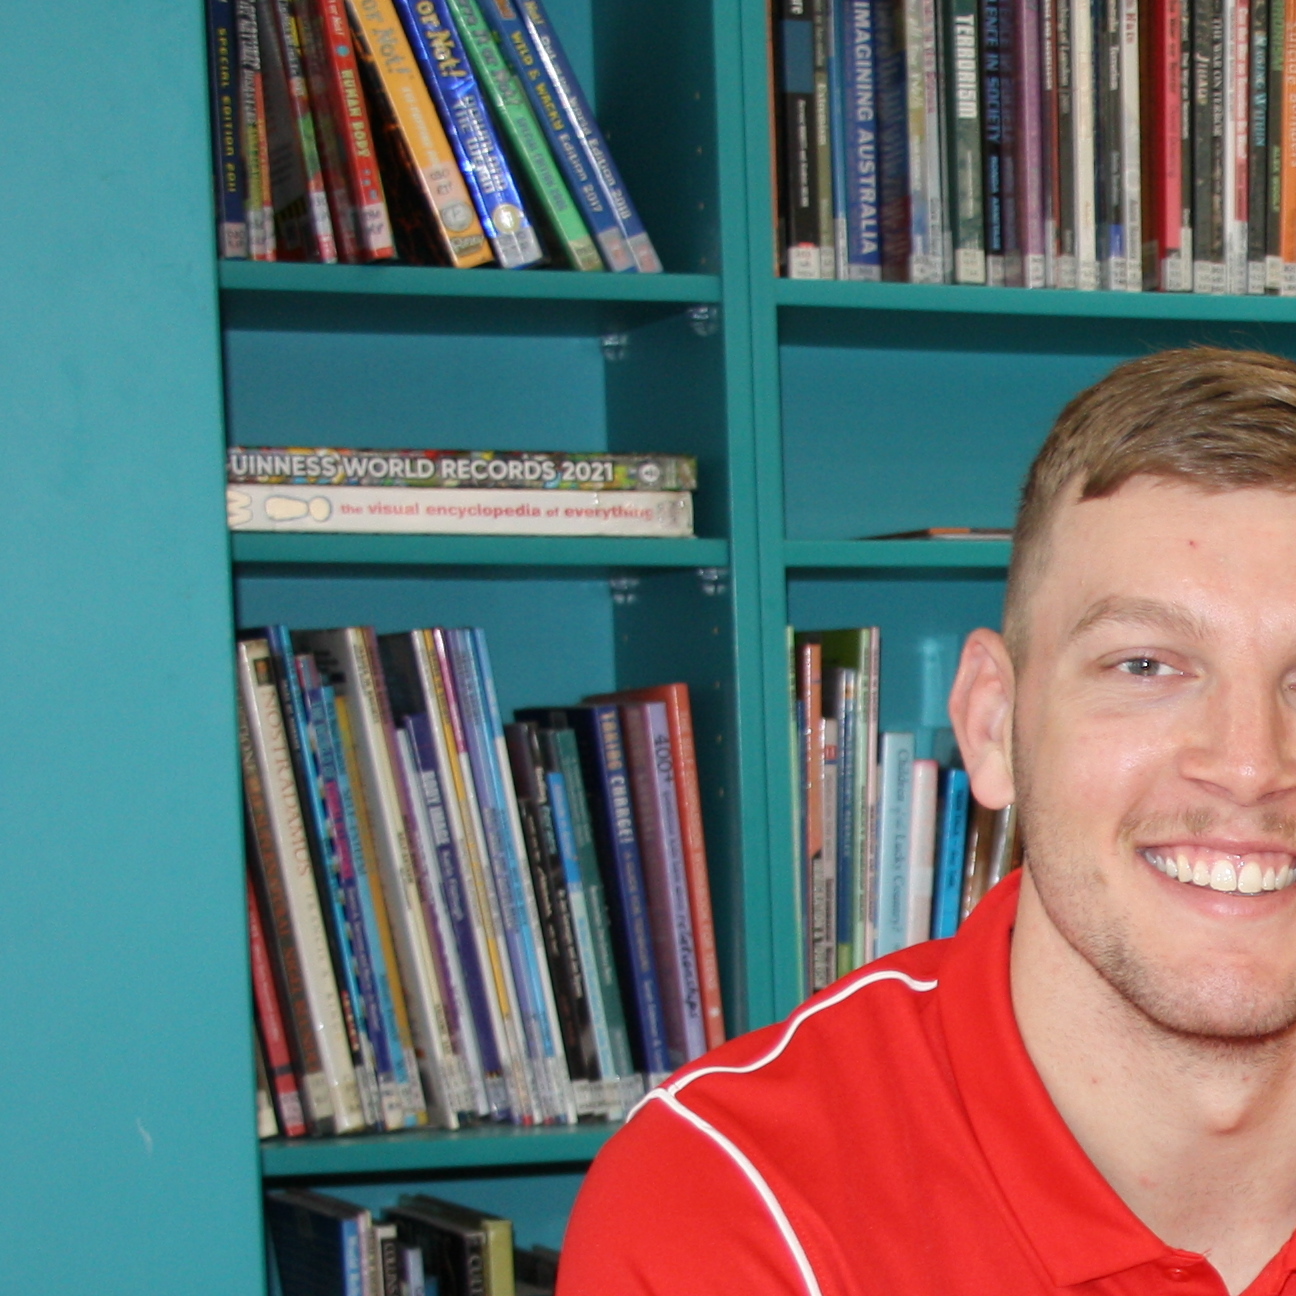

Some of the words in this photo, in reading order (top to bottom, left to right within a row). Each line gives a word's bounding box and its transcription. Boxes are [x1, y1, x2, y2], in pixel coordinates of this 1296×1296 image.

[426, 24, 467, 83] Not!
[853, 1, 873, 121] IMAGINING
[952, 13, 976, 118] TERRORISM
[985, 53, 1000, 71] IN
[1212, 42, 1223, 67] WAR
[340, 68, 361, 116] HUMAN
[986, 76, 1002, 144] SOCIETY
[1211, 90, 1222, 136] TERROR
[350, 120, 370, 159] BODY
[856, 128, 877, 252] AUSTRALIA
[231, 455, 339, 477] UINNESS
[342, 457, 435, 479] WORLD
[443, 458, 556, 481] RECORDS
[562, 460, 614, 482] 2021
[341, 502, 364, 516] the
[368, 502, 420, 516] visual
[426, 503, 541, 522] encyclopedia
[546, 505, 560, 517] of
[564, 504, 654, 522] everything
[598, 708, 622, 771] TAKING
[653, 732, 675, 785] 400+
[260, 688, 313, 877] NOSTRADAMUS
[895, 746, 911, 801] Children
[608, 774, 634, 845] CHARGE!
[892, 832, 907, 870] Lucky
[382, 1241, 399, 1294] COLLINS
